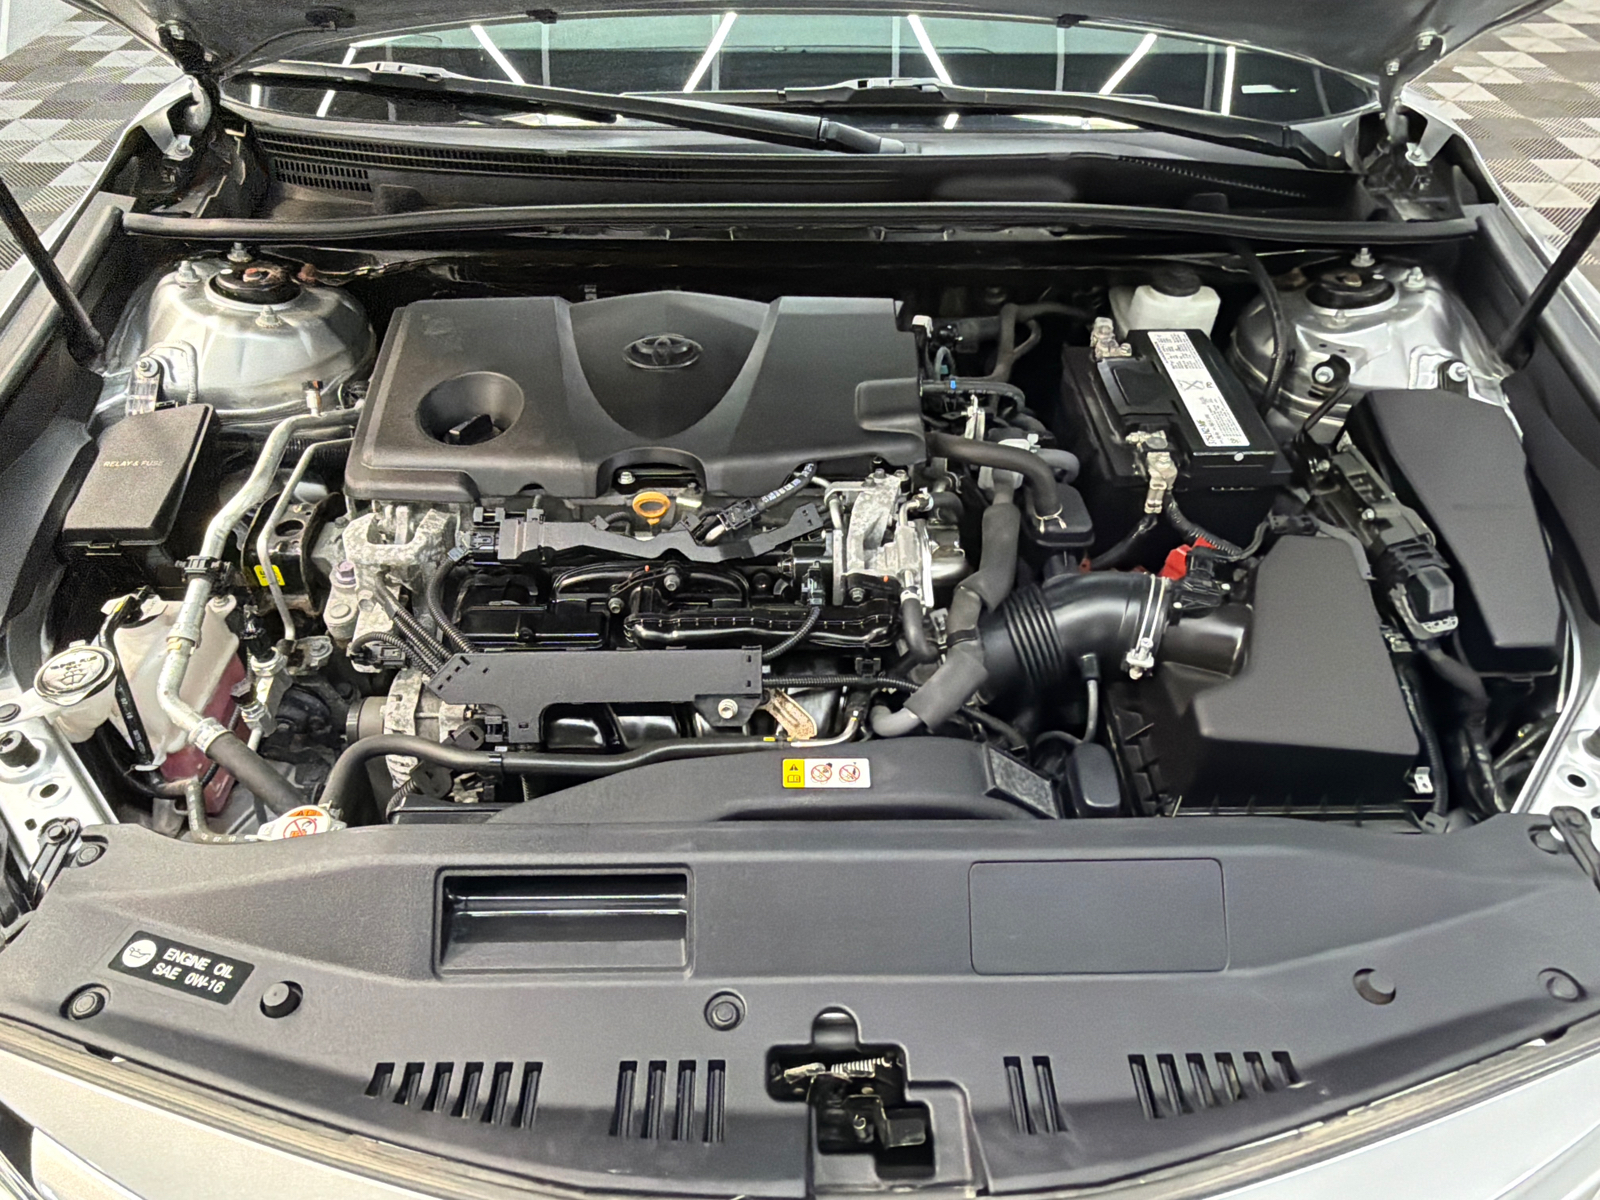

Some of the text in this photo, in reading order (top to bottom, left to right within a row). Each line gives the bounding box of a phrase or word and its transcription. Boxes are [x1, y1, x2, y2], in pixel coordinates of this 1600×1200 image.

[152, 962, 225, 994] SAE 0W-16
[162, 947, 234, 979] ENGINE OIL
